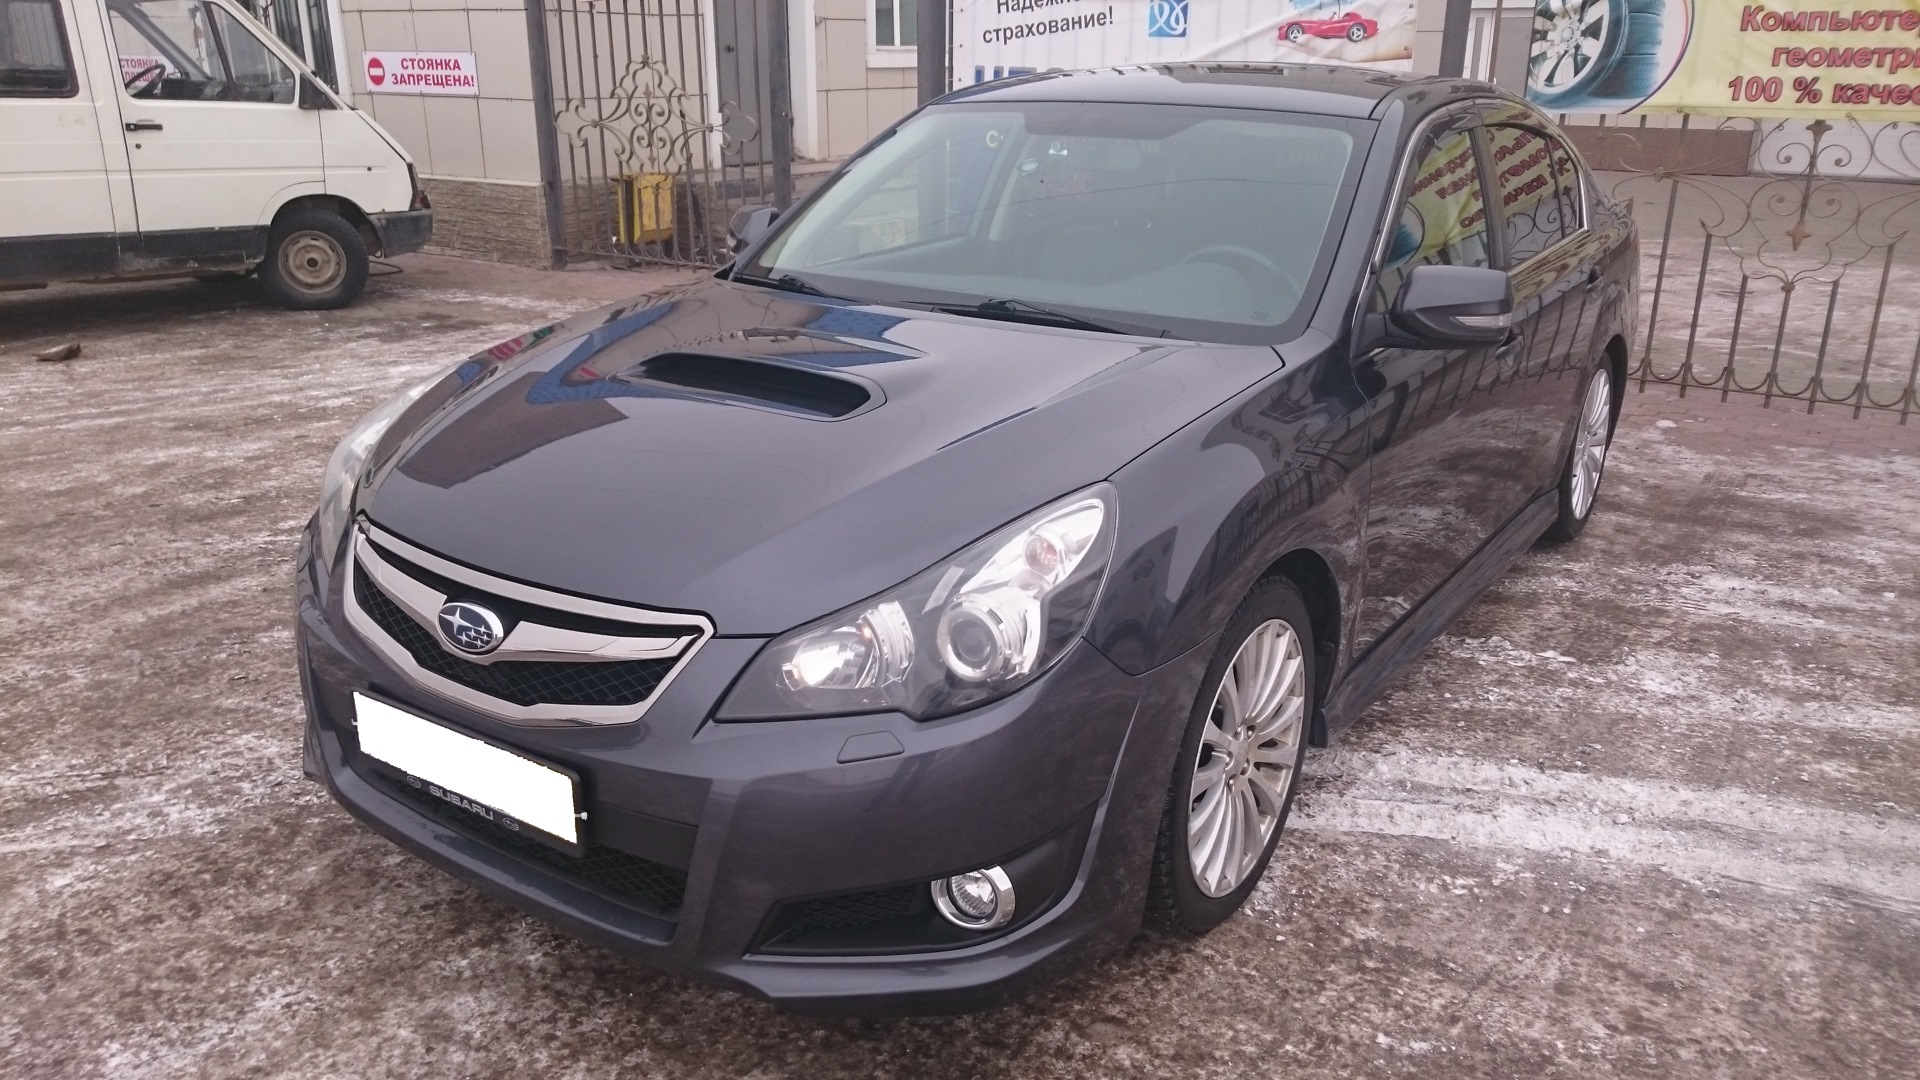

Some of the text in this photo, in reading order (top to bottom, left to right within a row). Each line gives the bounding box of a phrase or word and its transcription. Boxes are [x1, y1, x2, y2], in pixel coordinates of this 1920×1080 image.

[983, 5, 1113, 45] страхование!
[1740, 5, 1920, 36] Компьюте
[401, 58, 461, 71] СТОЯНКА
[391, 73, 475, 88] ЗАПРЕЩЕНА!
[1728, 75, 1783, 102] 100
[1793, 76, 1823, 104] %
[429, 785, 494, 821] SUBARU
